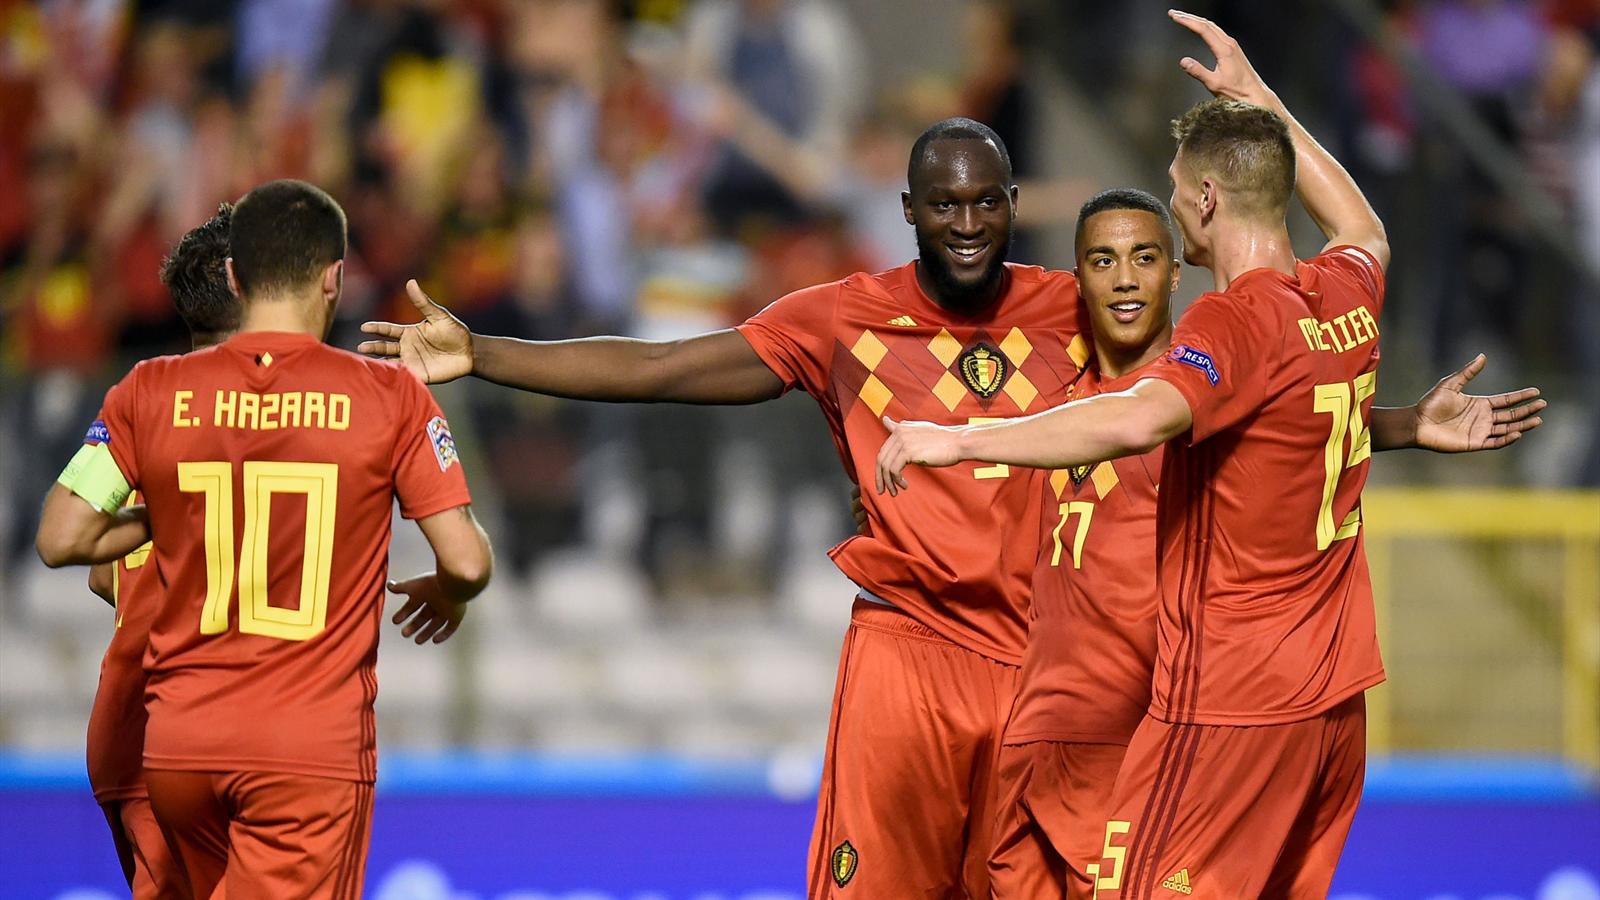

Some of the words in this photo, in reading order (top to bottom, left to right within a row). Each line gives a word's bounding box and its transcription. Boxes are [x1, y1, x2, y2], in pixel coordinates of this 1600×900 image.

[1184, 351, 1219, 382] RESPECT
[173, 390, 201, 428] E.
[214, 390, 351, 431] HAZARD
[177, 461, 339, 641] 10
[1050, 501, 1095, 570] 17
[1162, 880, 1193, 896] adidas
